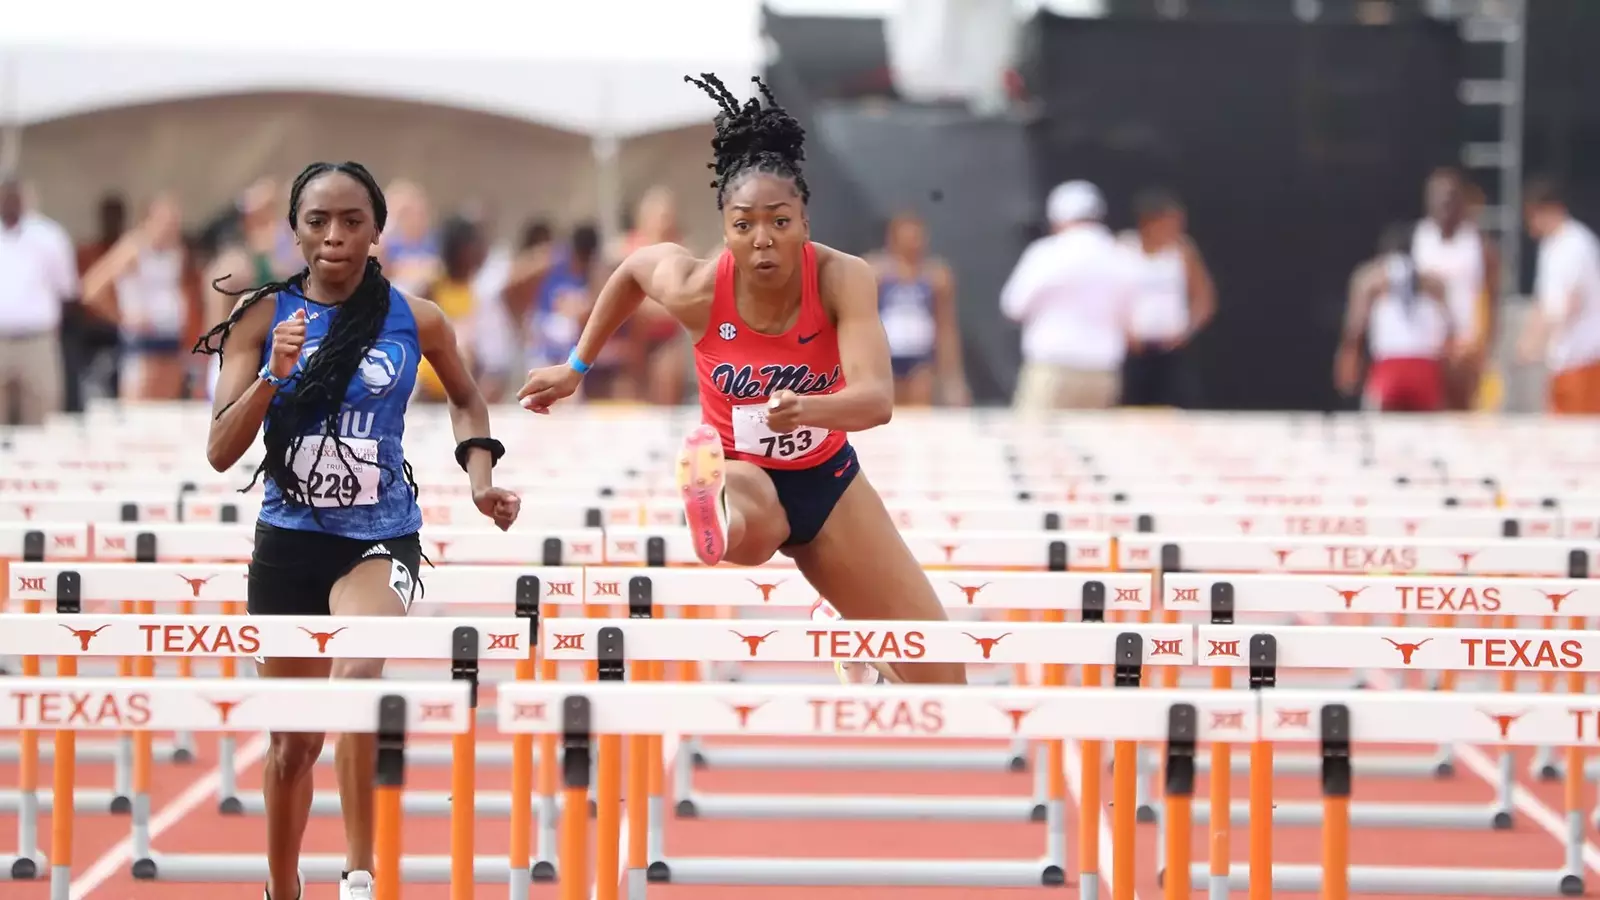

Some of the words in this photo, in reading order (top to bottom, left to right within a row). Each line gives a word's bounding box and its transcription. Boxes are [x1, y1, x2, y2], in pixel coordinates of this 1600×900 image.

[719, 323, 736, 340] SEC
[711, 363, 761, 400] Ole
[760, 430, 812, 457] 753
[326, 463, 353, 471] TRUIS
[309, 472, 360, 499] 229
[1326, 547, 1418, 570] TEXAS
[1395, 587, 1501, 612] TEXAS
[139, 625, 261, 653] TEXAS
[487, 633, 520, 650] XII
[553, 633, 585, 650] XII
[806, 630, 926, 659] TEXAS
[1151, 639, 1183, 656] XII
[1208, 640, 1240, 657] XII
[1460, 639, 1583, 669] TEXAS
[11, 691, 152, 726] TEXAS
[808, 699, 945, 733] TEXAS
